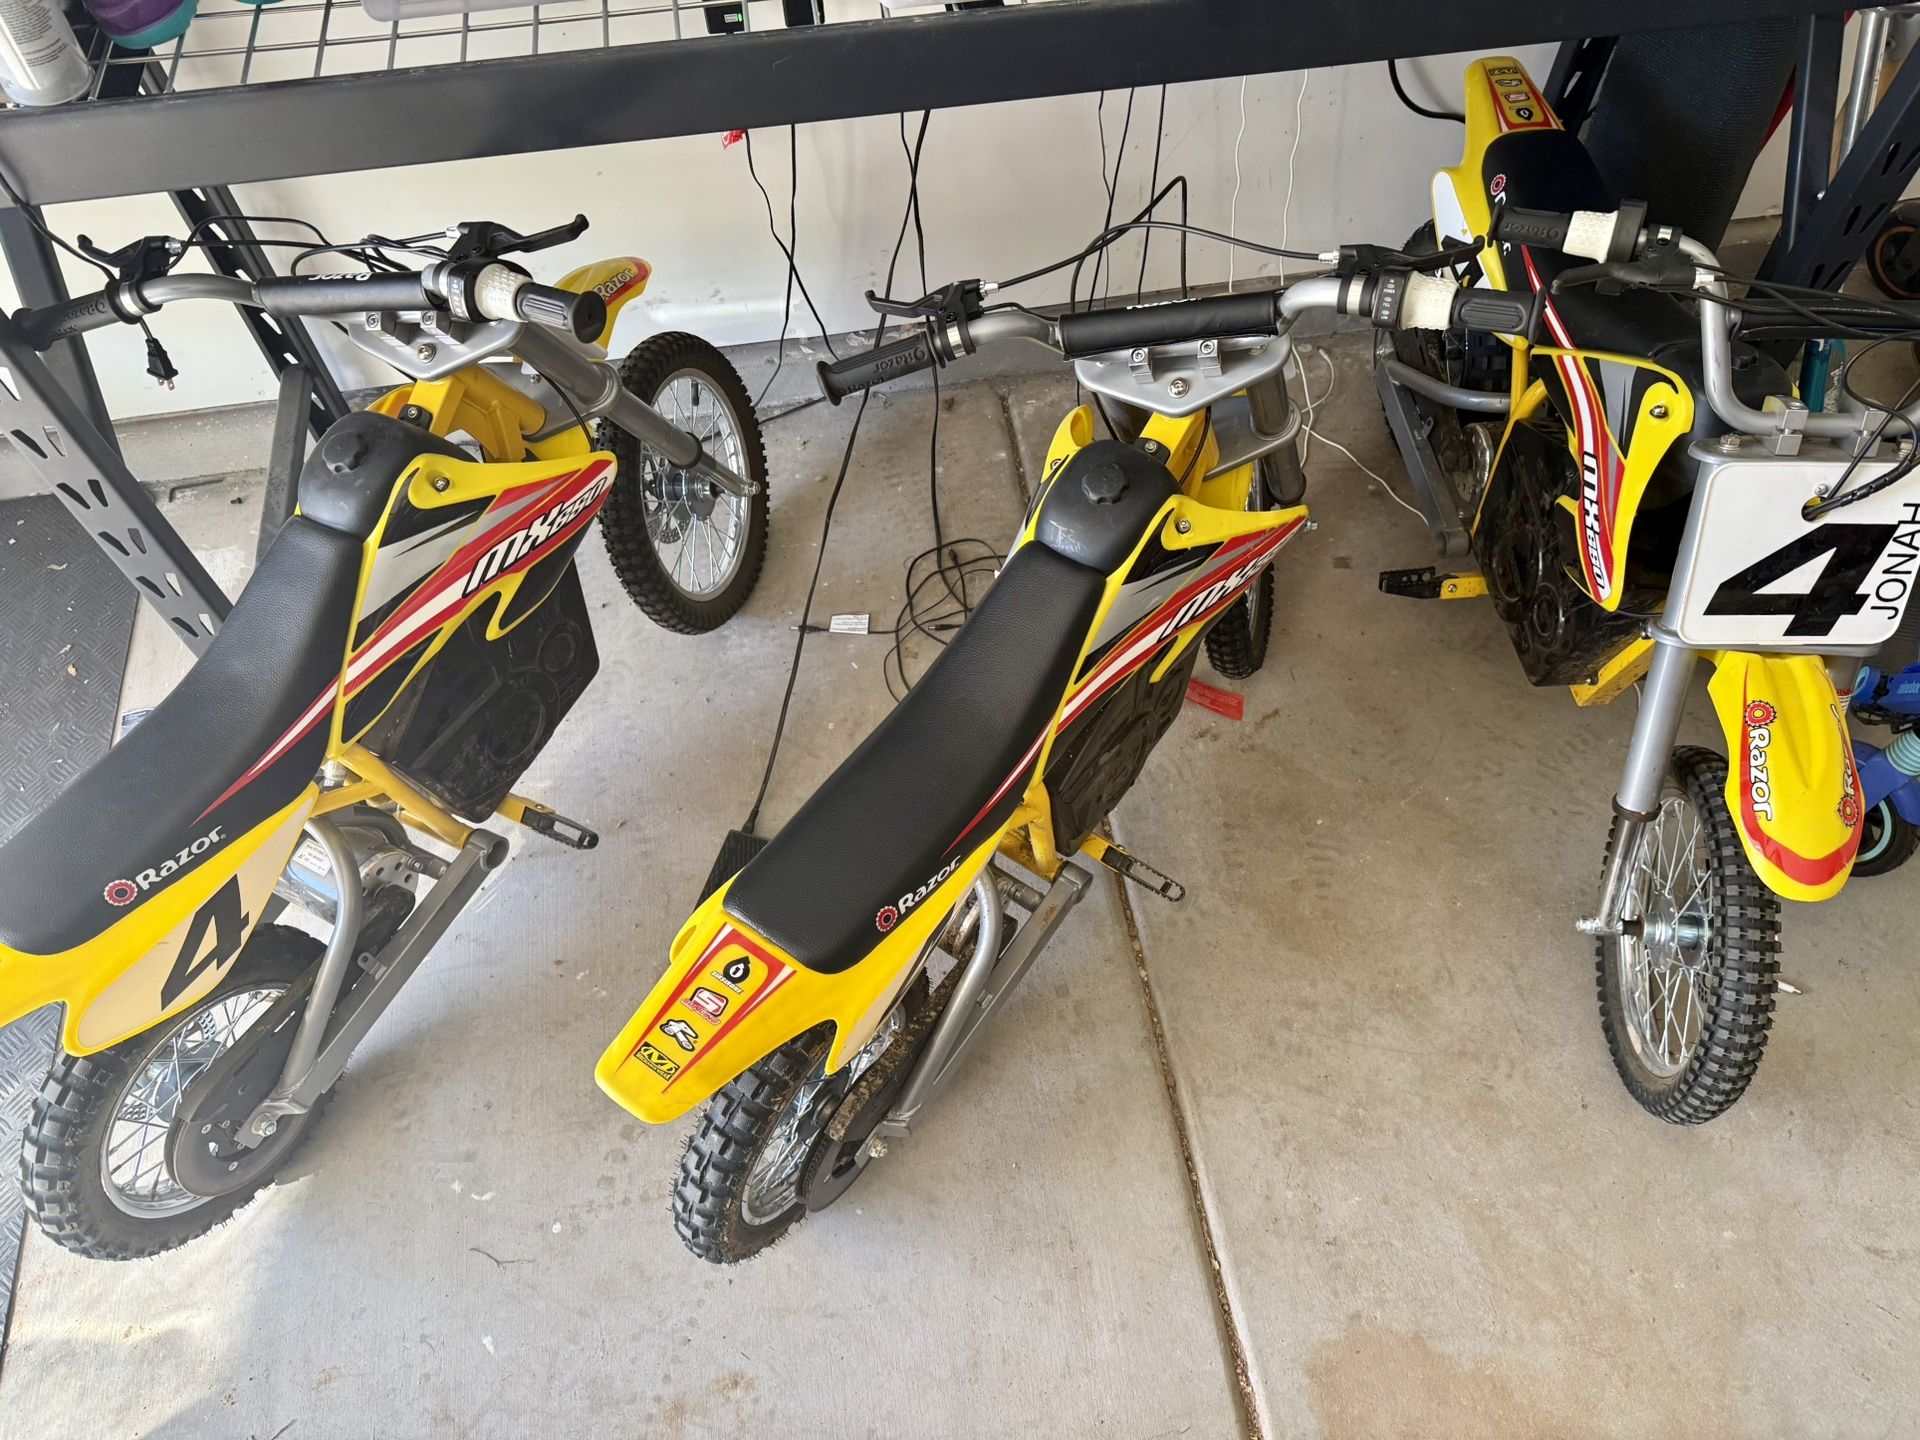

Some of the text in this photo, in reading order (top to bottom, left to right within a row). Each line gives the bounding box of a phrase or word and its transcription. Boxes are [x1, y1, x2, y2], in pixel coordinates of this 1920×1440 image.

[592, 267, 635, 300] Razor
[1703, 523, 1901, 636] 4
[1870, 503, 1920, 620] JONAH
[1749, 725, 1772, 821] Razor
[135, 825, 222, 890] Razor
[898, 855, 961, 914] Razor
[161, 873, 249, 1012] 4
